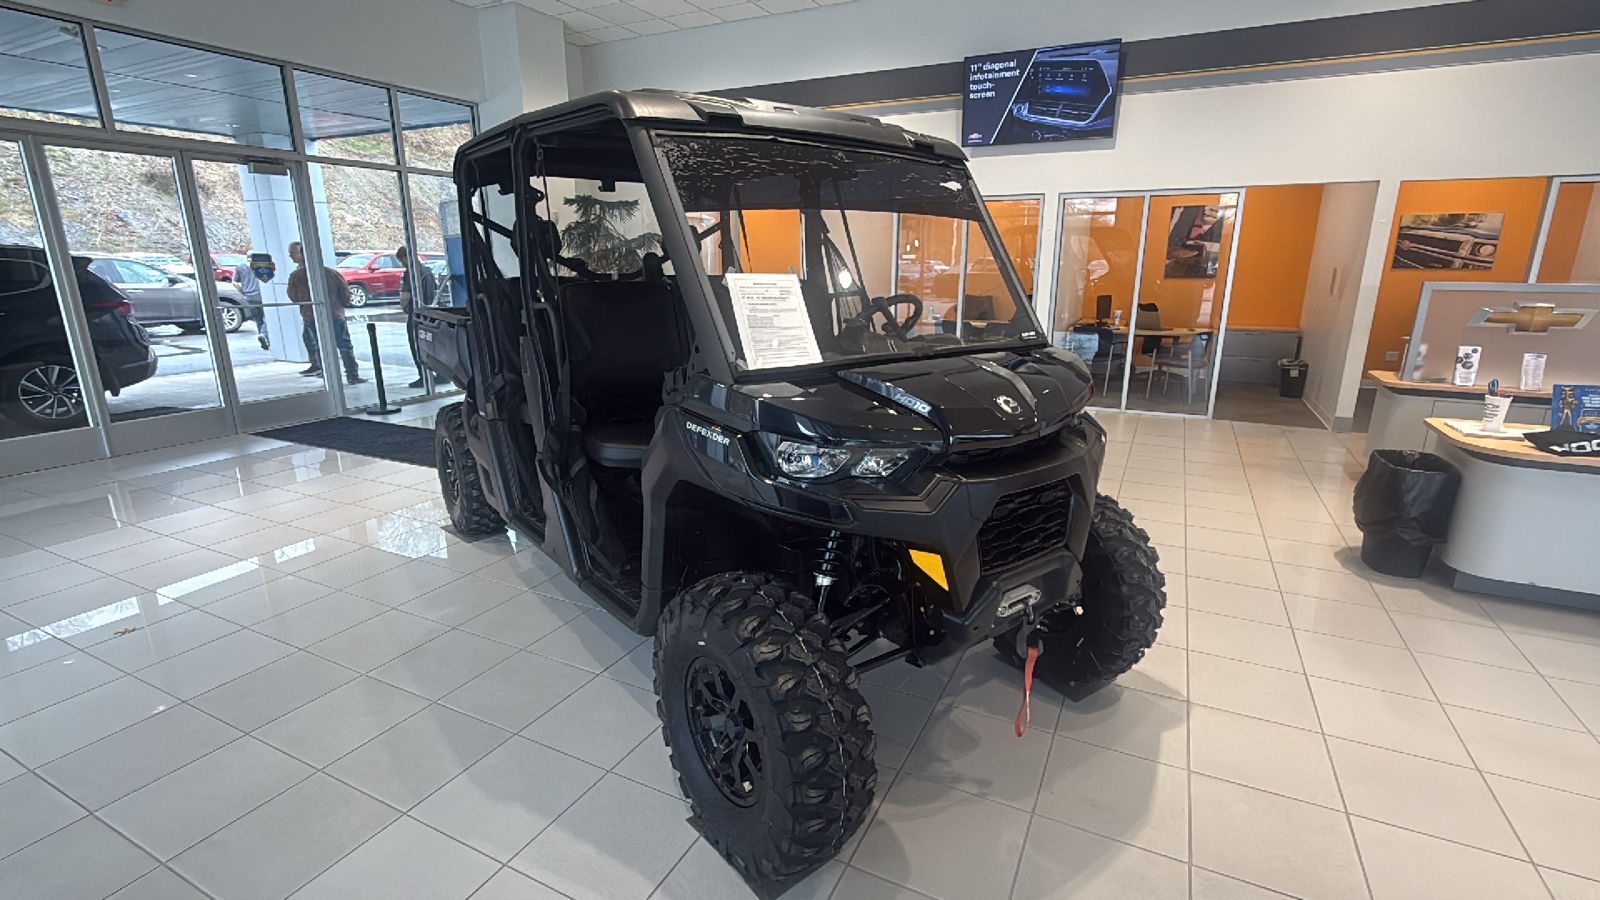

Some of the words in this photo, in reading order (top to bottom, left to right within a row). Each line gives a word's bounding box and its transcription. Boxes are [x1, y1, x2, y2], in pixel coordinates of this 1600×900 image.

[983, 58, 1017, 71] diagonal
[969, 69, 1020, 81] infotainment
[969, 81, 995, 90] touch-
[969, 91, 996, 99] screen
[686, 421, 730, 446] DEFENDER
